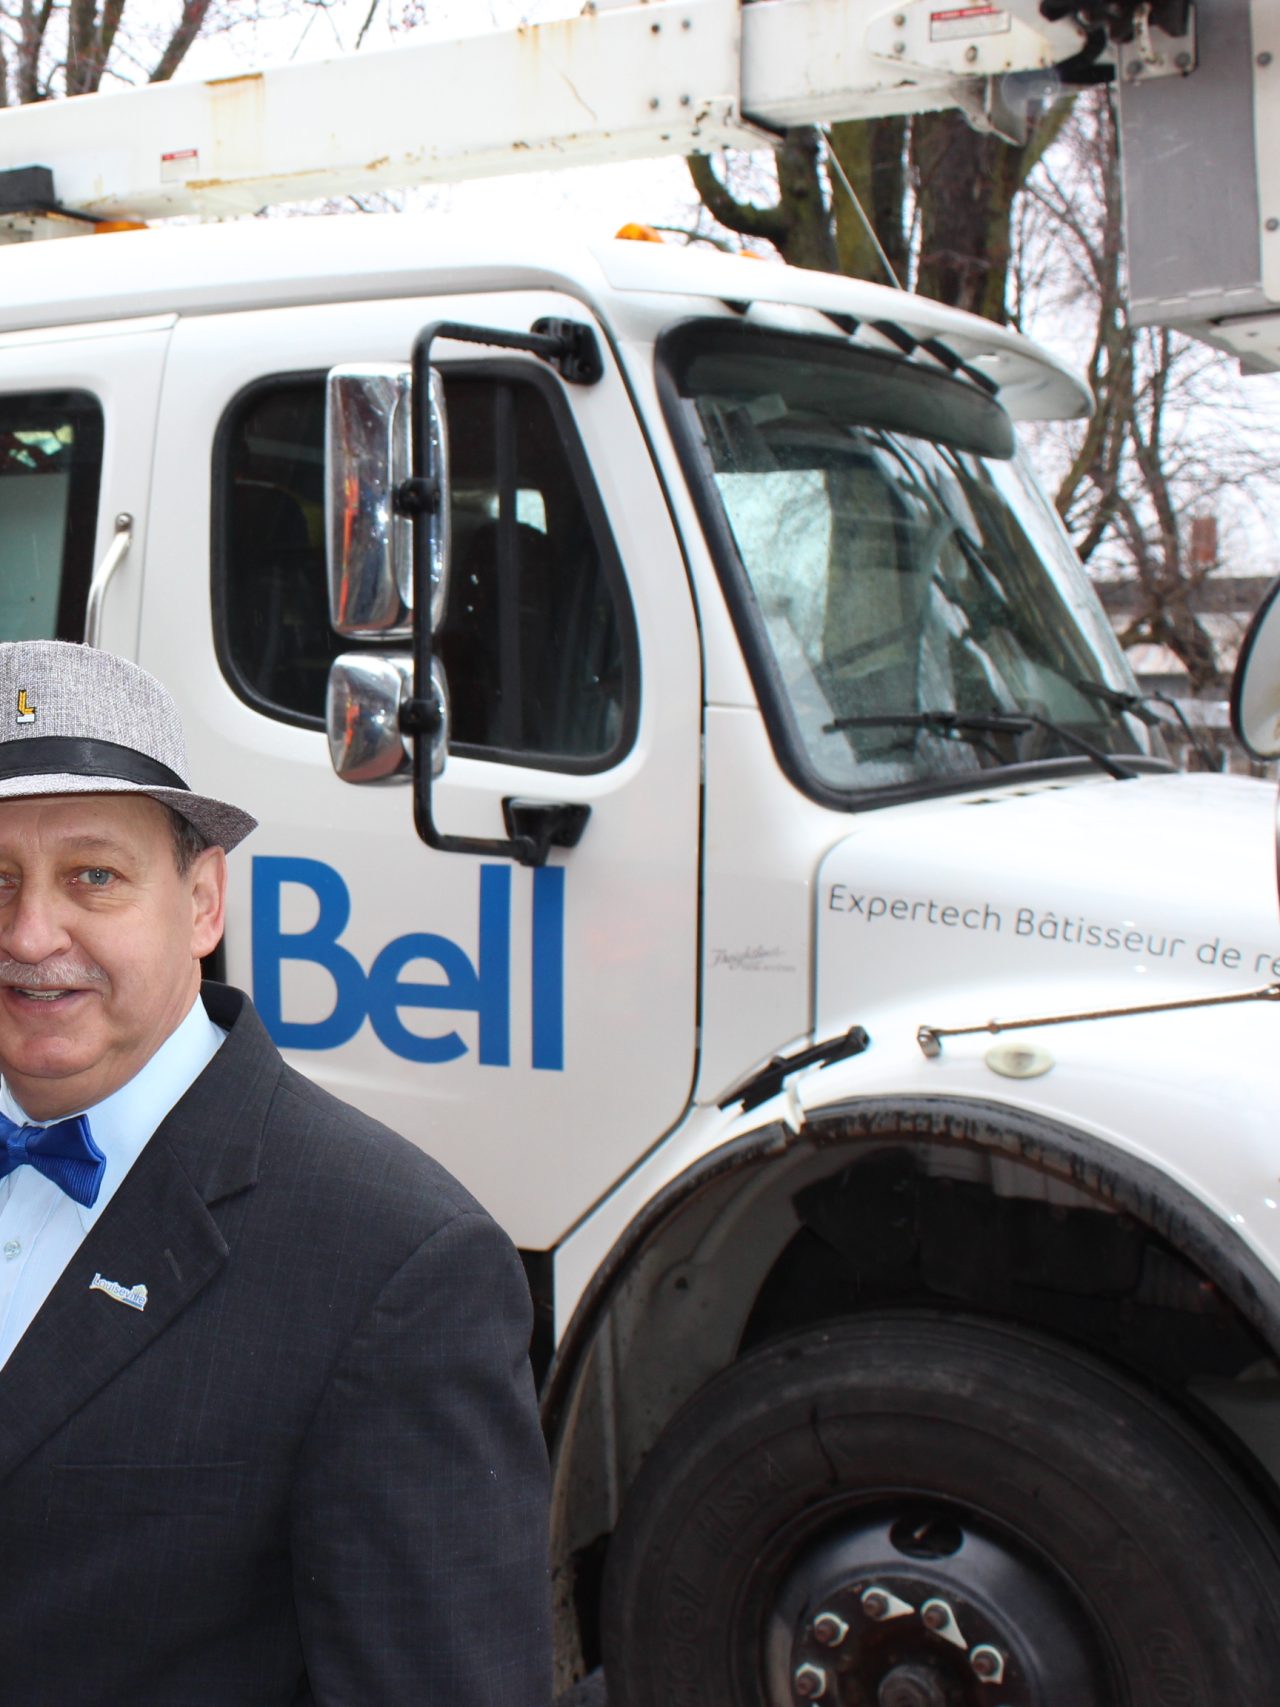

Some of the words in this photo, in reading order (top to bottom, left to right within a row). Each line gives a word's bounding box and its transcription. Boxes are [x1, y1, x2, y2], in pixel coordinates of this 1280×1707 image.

[252, 856, 565, 1071] Bell
[828, 883, 1001, 932] Expertech
[1014, 907, 1187, 958] Bâtisseur
[1196, 937, 1241, 969] de
